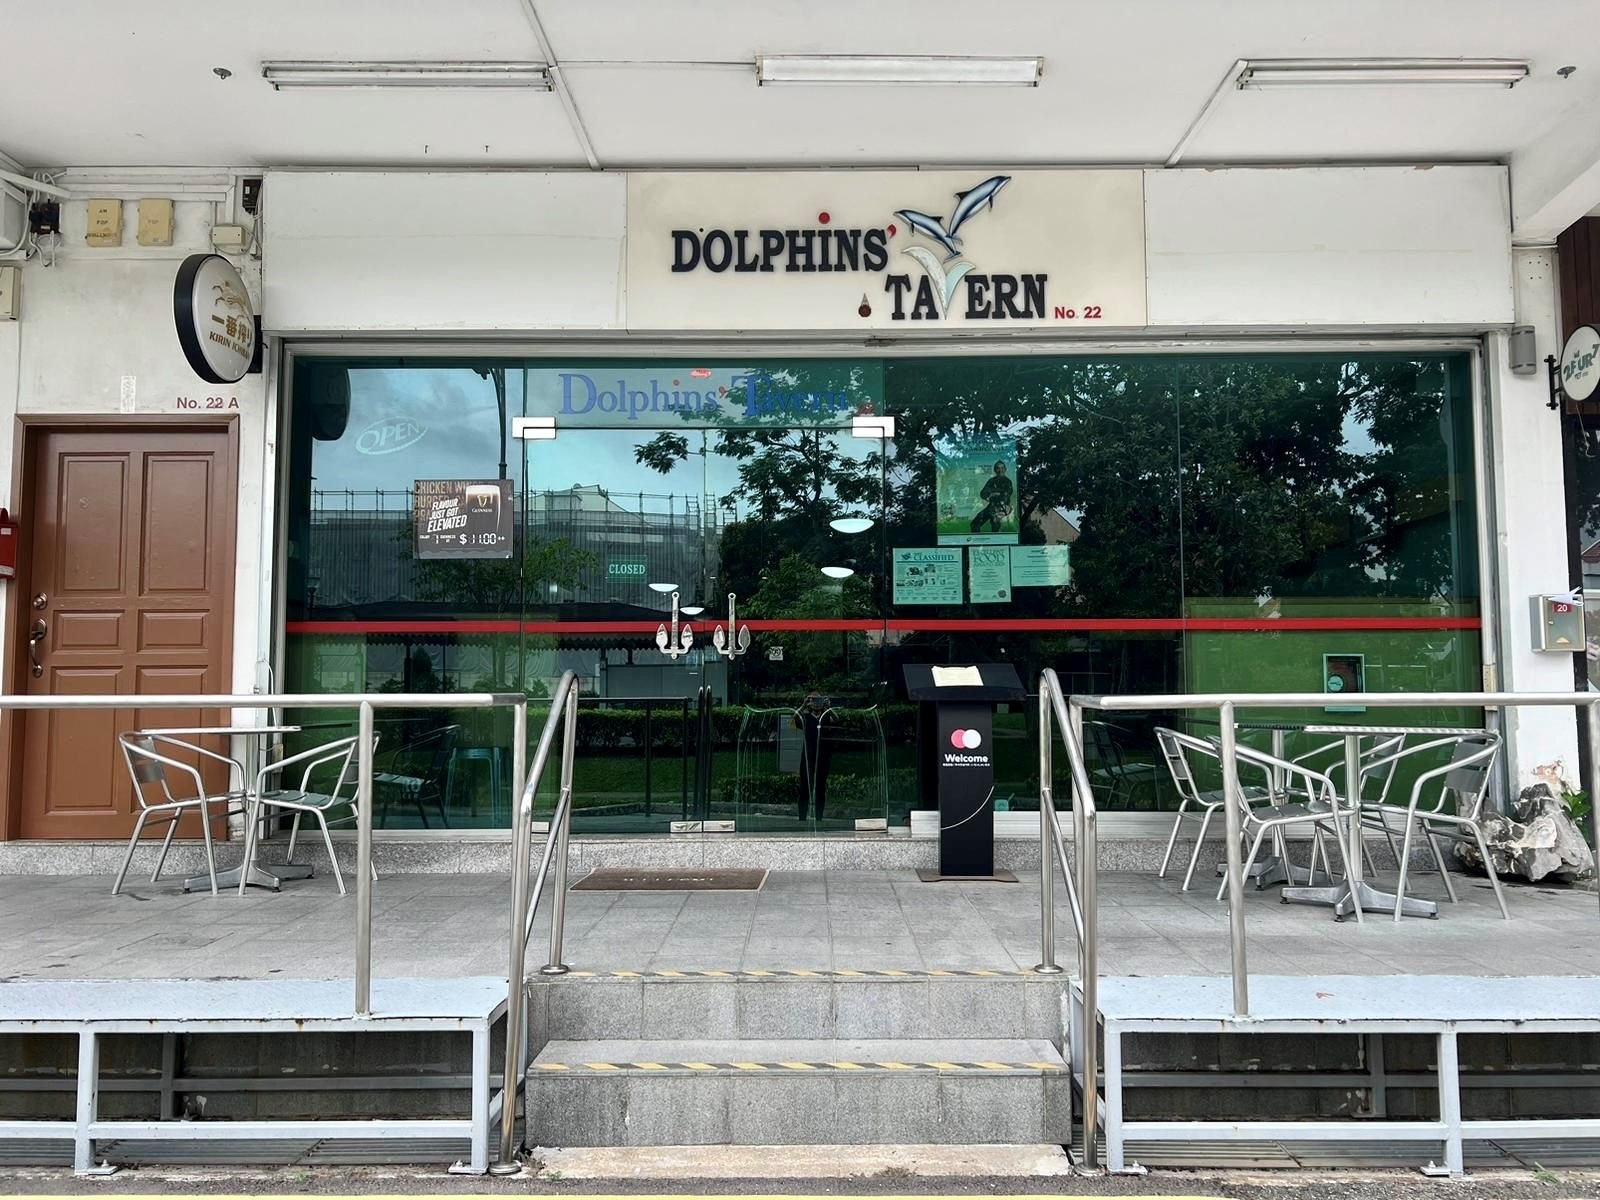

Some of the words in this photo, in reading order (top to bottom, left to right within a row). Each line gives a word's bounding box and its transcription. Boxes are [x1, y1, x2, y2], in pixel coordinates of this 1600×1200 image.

[885, 248, 1048, 320] TAVERN
[1054, 305, 1079, 320] No.
[1083, 306, 1102, 319] 22
[209, 331, 231, 348] KIRIN
[176, 396, 201, 409] No.
[205, 397, 223, 409] 22
[228, 397, 240, 409] A
[730, 375, 849, 417] Tavern
[356, 423, 420, 450] OPEN
[414, 481, 452, 494] CHICKEN
[432, 498, 459, 511] FLAVOUR
[429, 509, 446, 520] JUST
[446, 507, 460, 517] GOT
[427, 514, 467, 532] ELEVATED
[608, 563, 646, 575] CLOSED
[1556, 603, 1568, 612] 20
[944, 753, 989, 763] Welcome
